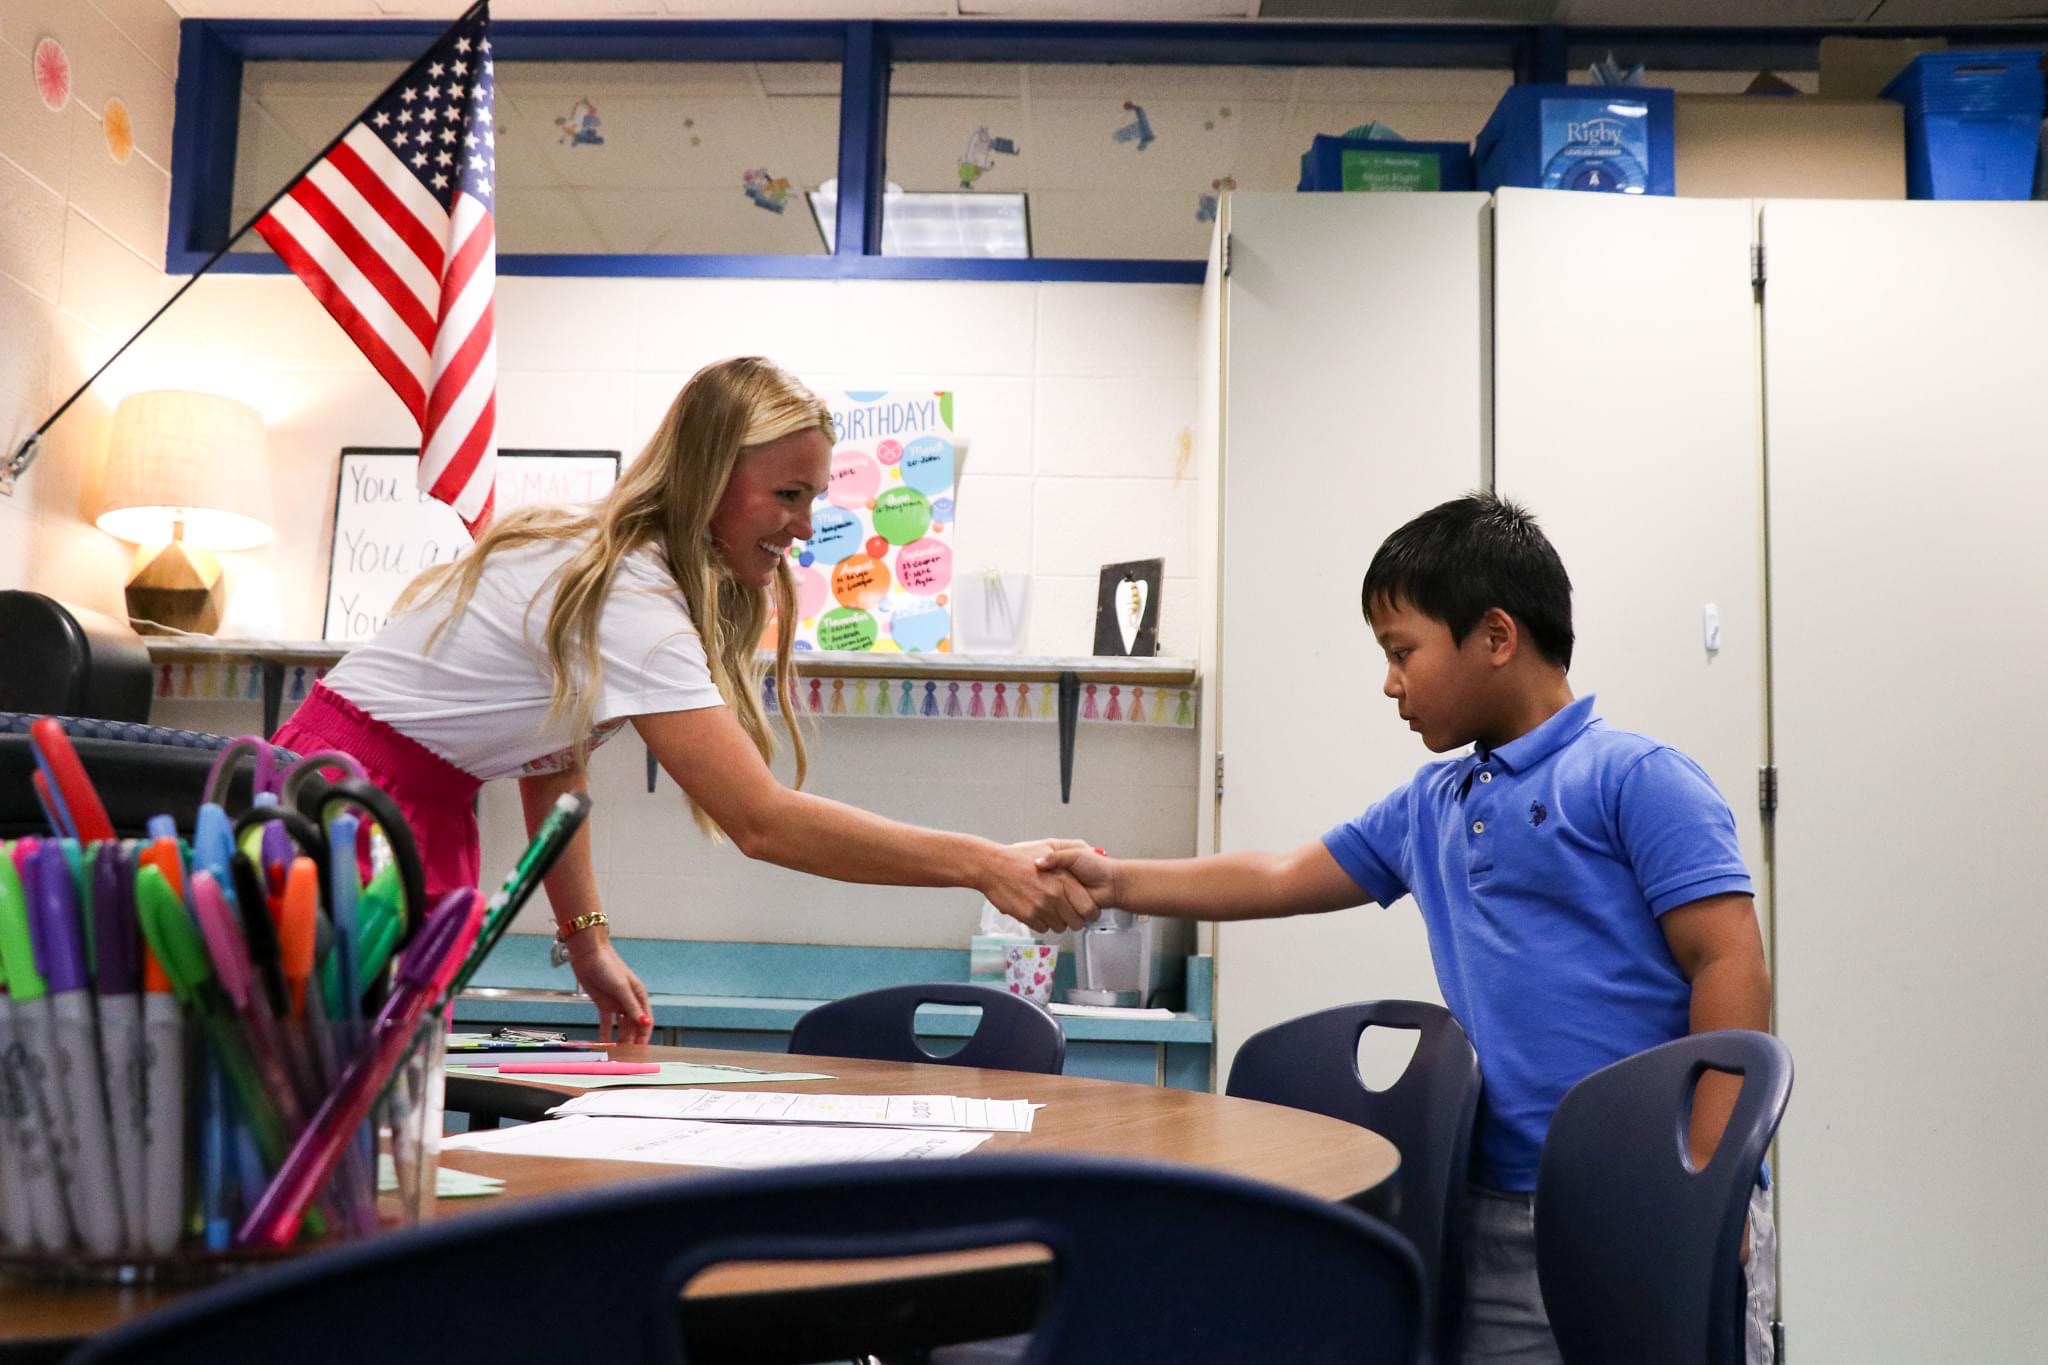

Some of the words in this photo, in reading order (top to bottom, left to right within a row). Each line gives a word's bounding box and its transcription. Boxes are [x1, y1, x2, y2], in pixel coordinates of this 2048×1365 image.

[1567, 121, 1622, 146] Rigby
[833, 399, 936, 441] BIRTHDAY!
[351, 464, 402, 504] You
[344, 528, 408, 573] You
